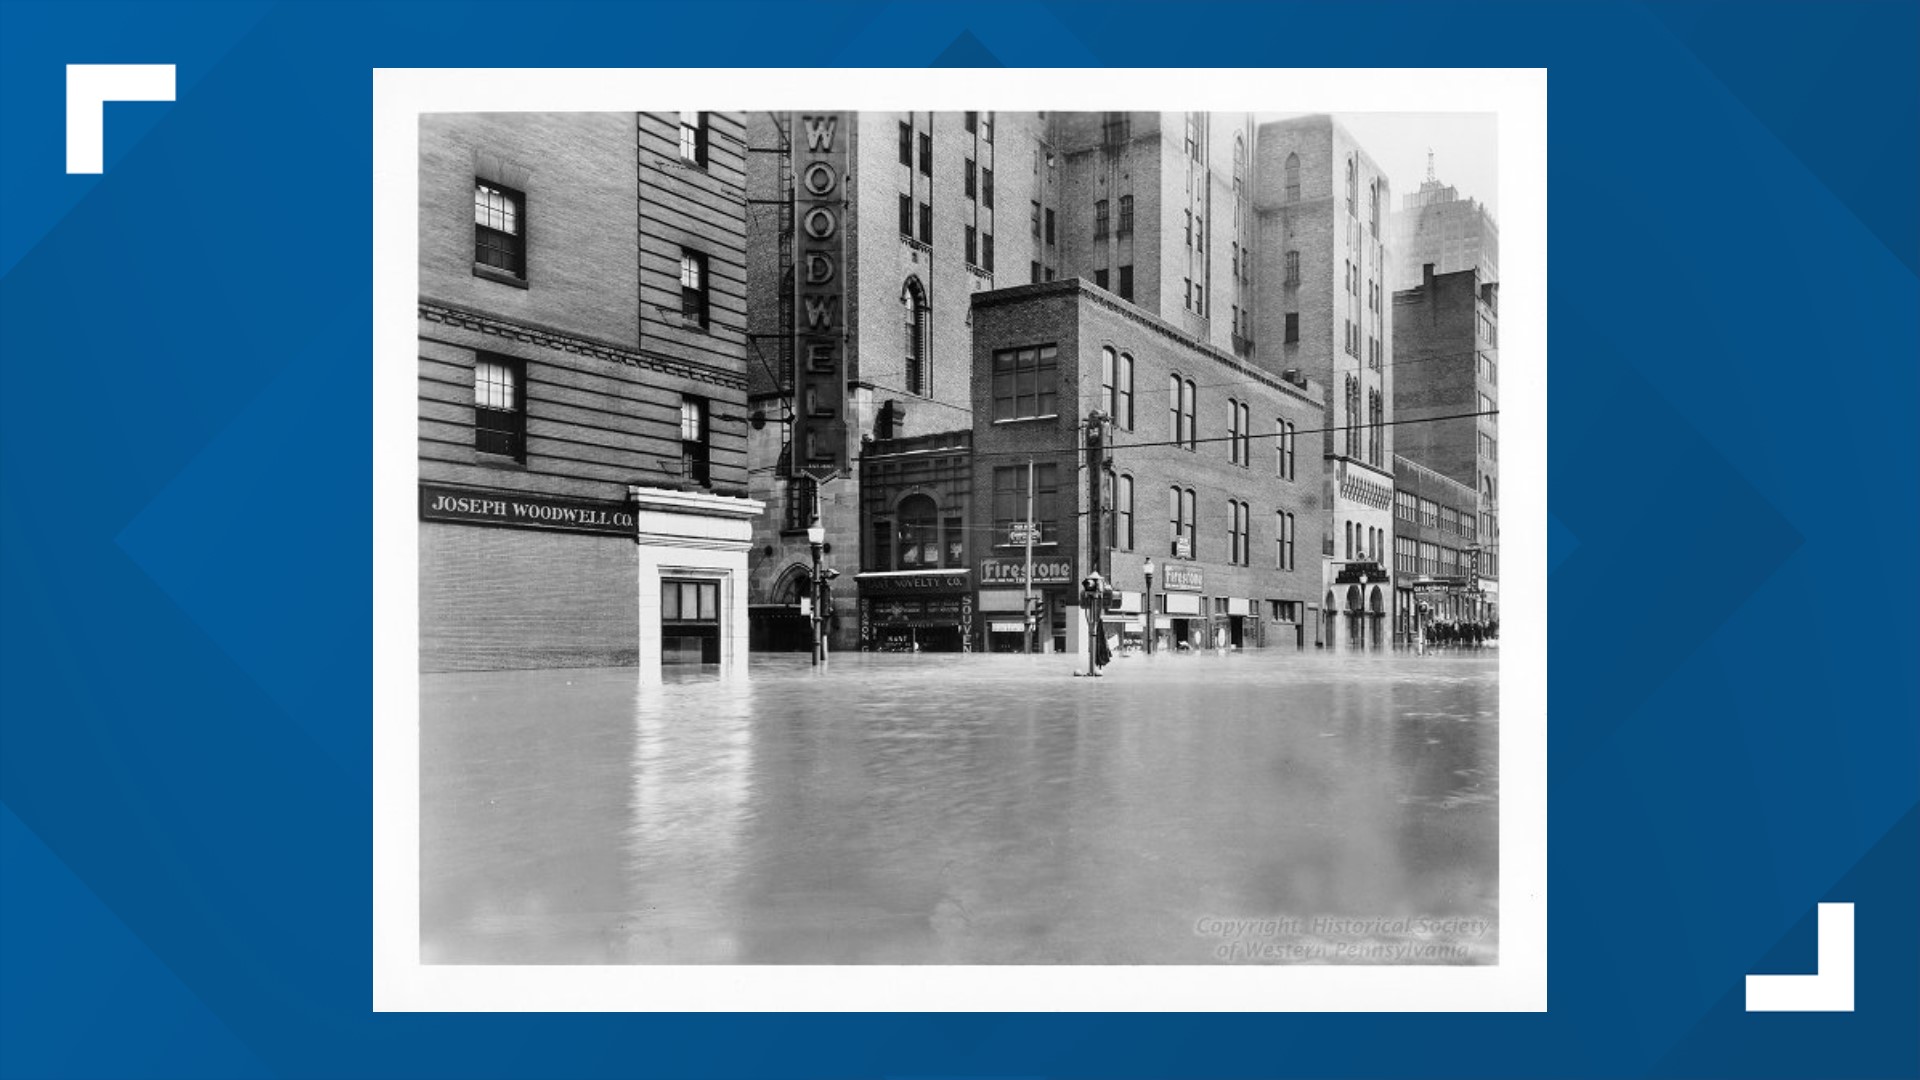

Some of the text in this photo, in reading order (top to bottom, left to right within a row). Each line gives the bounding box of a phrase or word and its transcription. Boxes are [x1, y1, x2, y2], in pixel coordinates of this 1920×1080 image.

[803, 115, 838, 462] WOODWELL
[431, 496, 634, 527] JOSEPH WOODWELL CO.
[982, 559, 1071, 579] Firestone
